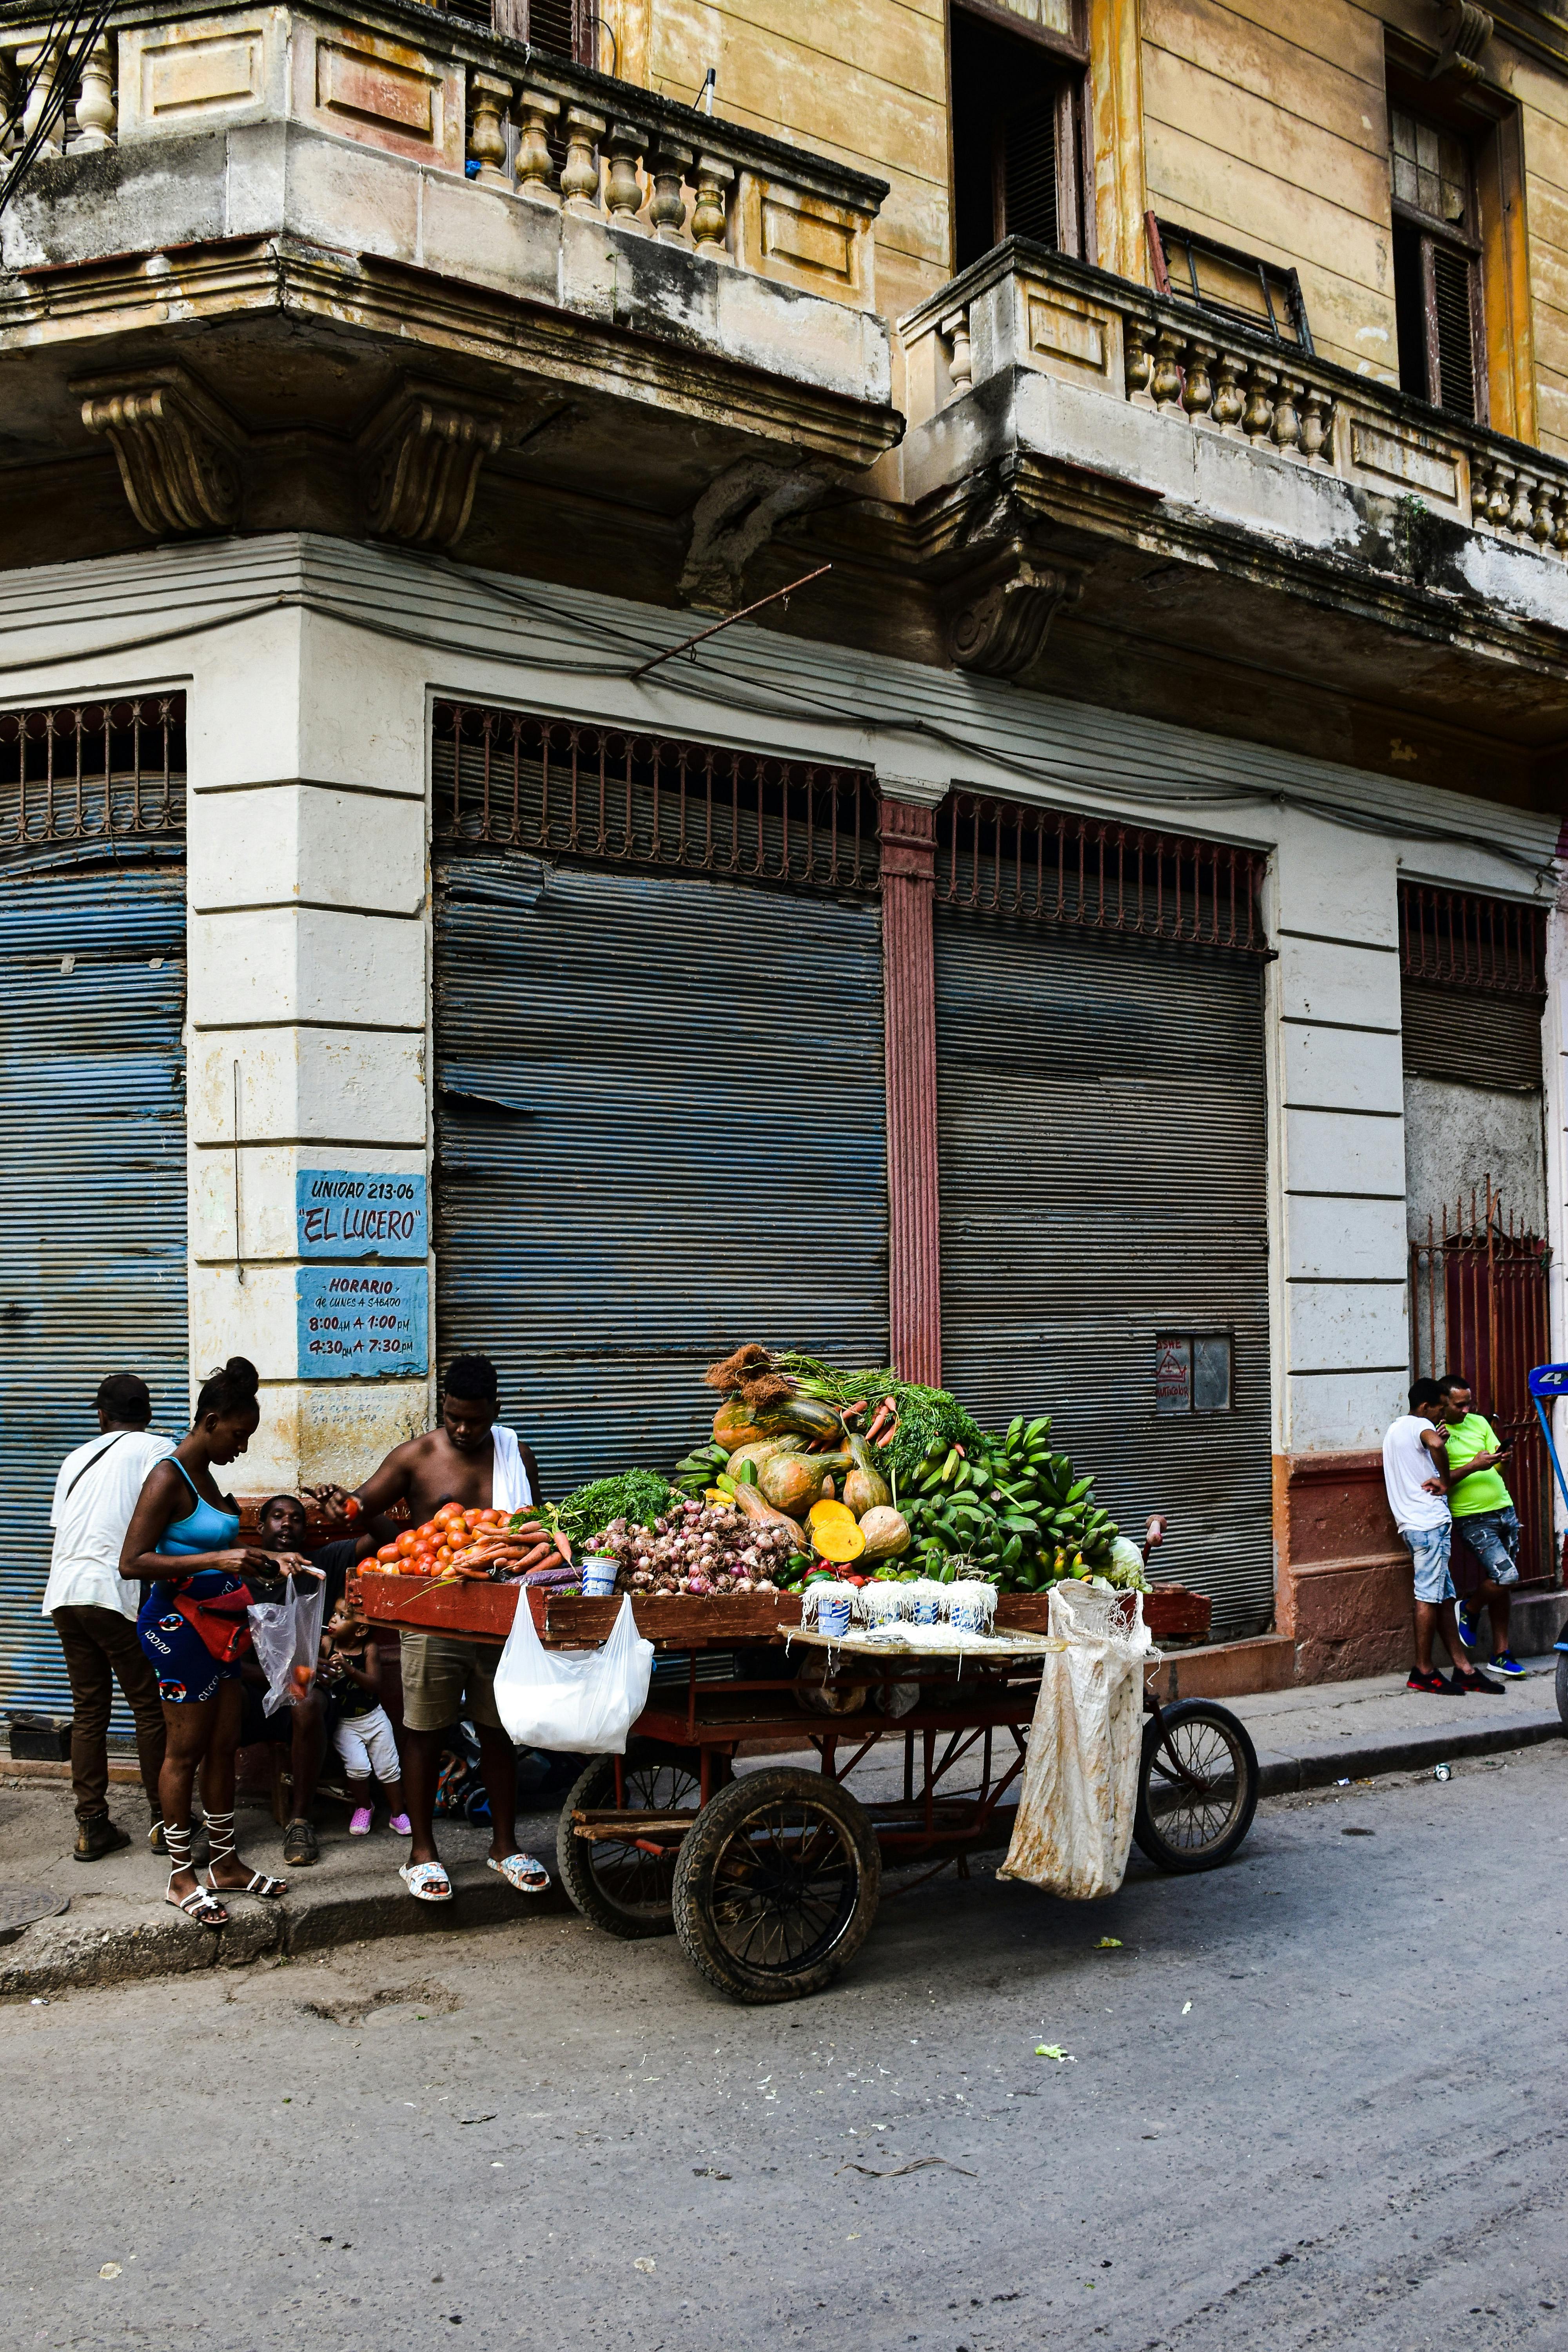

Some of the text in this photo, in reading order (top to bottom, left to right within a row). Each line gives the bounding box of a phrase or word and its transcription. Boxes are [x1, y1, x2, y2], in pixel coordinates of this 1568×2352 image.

[312, 1181, 365, 1198] UNIDAD
[329, 1278, 393, 1294] HORARIO
[330, 1298, 356, 1307] LUNES
[358, 1298, 365, 1307] A
[353, 1317, 364, 1329] A
[353, 1340, 364, 1352] A
[145, 1630, 171, 1654] GUCCI
[199, 1675, 219, 1700] GUCCI
